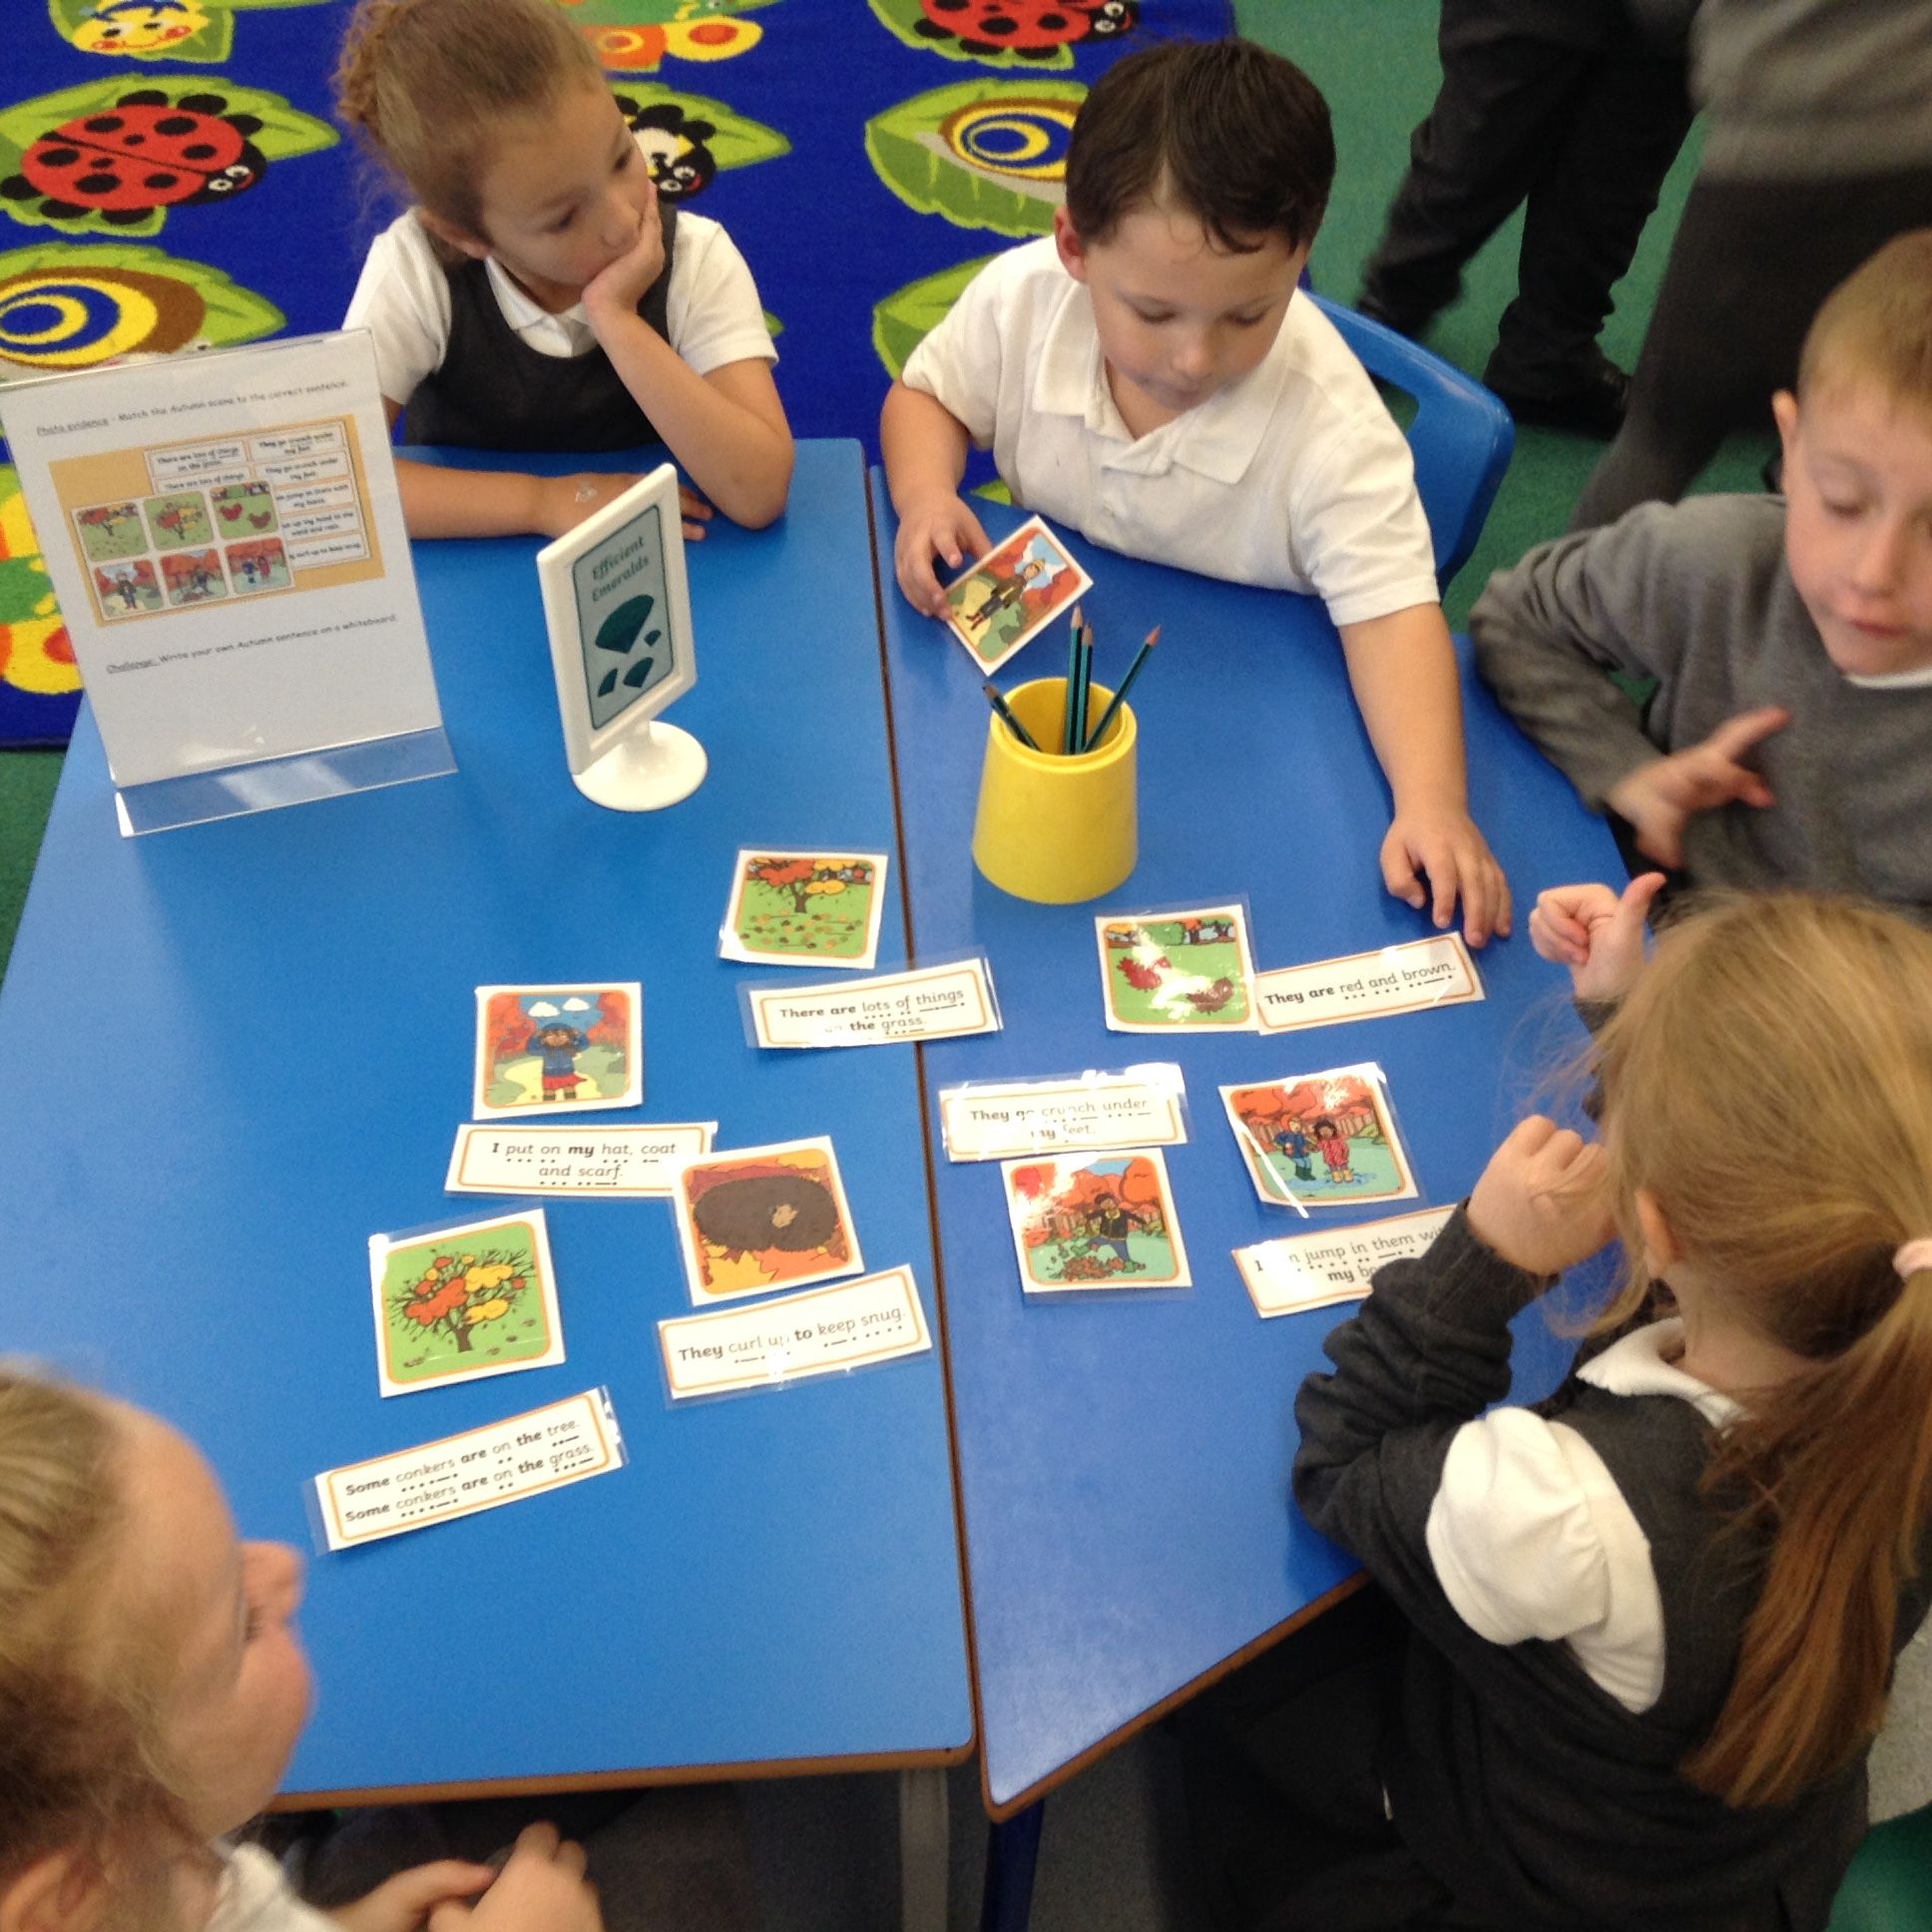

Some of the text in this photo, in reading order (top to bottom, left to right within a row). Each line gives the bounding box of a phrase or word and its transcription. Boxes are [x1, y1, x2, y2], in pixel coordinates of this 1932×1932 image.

[592, 535, 645, 581] Efficient
[591, 556, 650, 603] Emeralds
[1264, 961, 1457, 1006] They are red and brown.
[779, 988, 965, 1020] There are lots of things
[849, 1019, 876, 1032] the
[880, 1015, 927, 1034] grass.
[969, 1109, 1011, 1124] They
[1041, 1101, 1097, 1118] crunch
[1102, 1097, 1149, 1112] under
[491, 1142, 678, 1159] I put on my hat, coat
[538, 1163, 624, 1181] and scarf.
[1303, 1245, 1346, 1264] jump
[1350, 1240, 1369, 1255] in
[1371, 1233, 1416, 1251] them
[1419, 1225, 1445, 1242] wi
[1327, 1269, 1356, 1284] my
[677, 1343, 724, 1362] They
[727, 1335, 763, 1354] curl
[794, 1328, 813, 1342] to
[816, 1317, 856, 1337] keep
[859, 1305, 908, 1328] snug.
[345, 1418, 581, 1497] Some conkers are on the tree.
[345, 1442, 596, 1523] Some conkers are on the grass.
